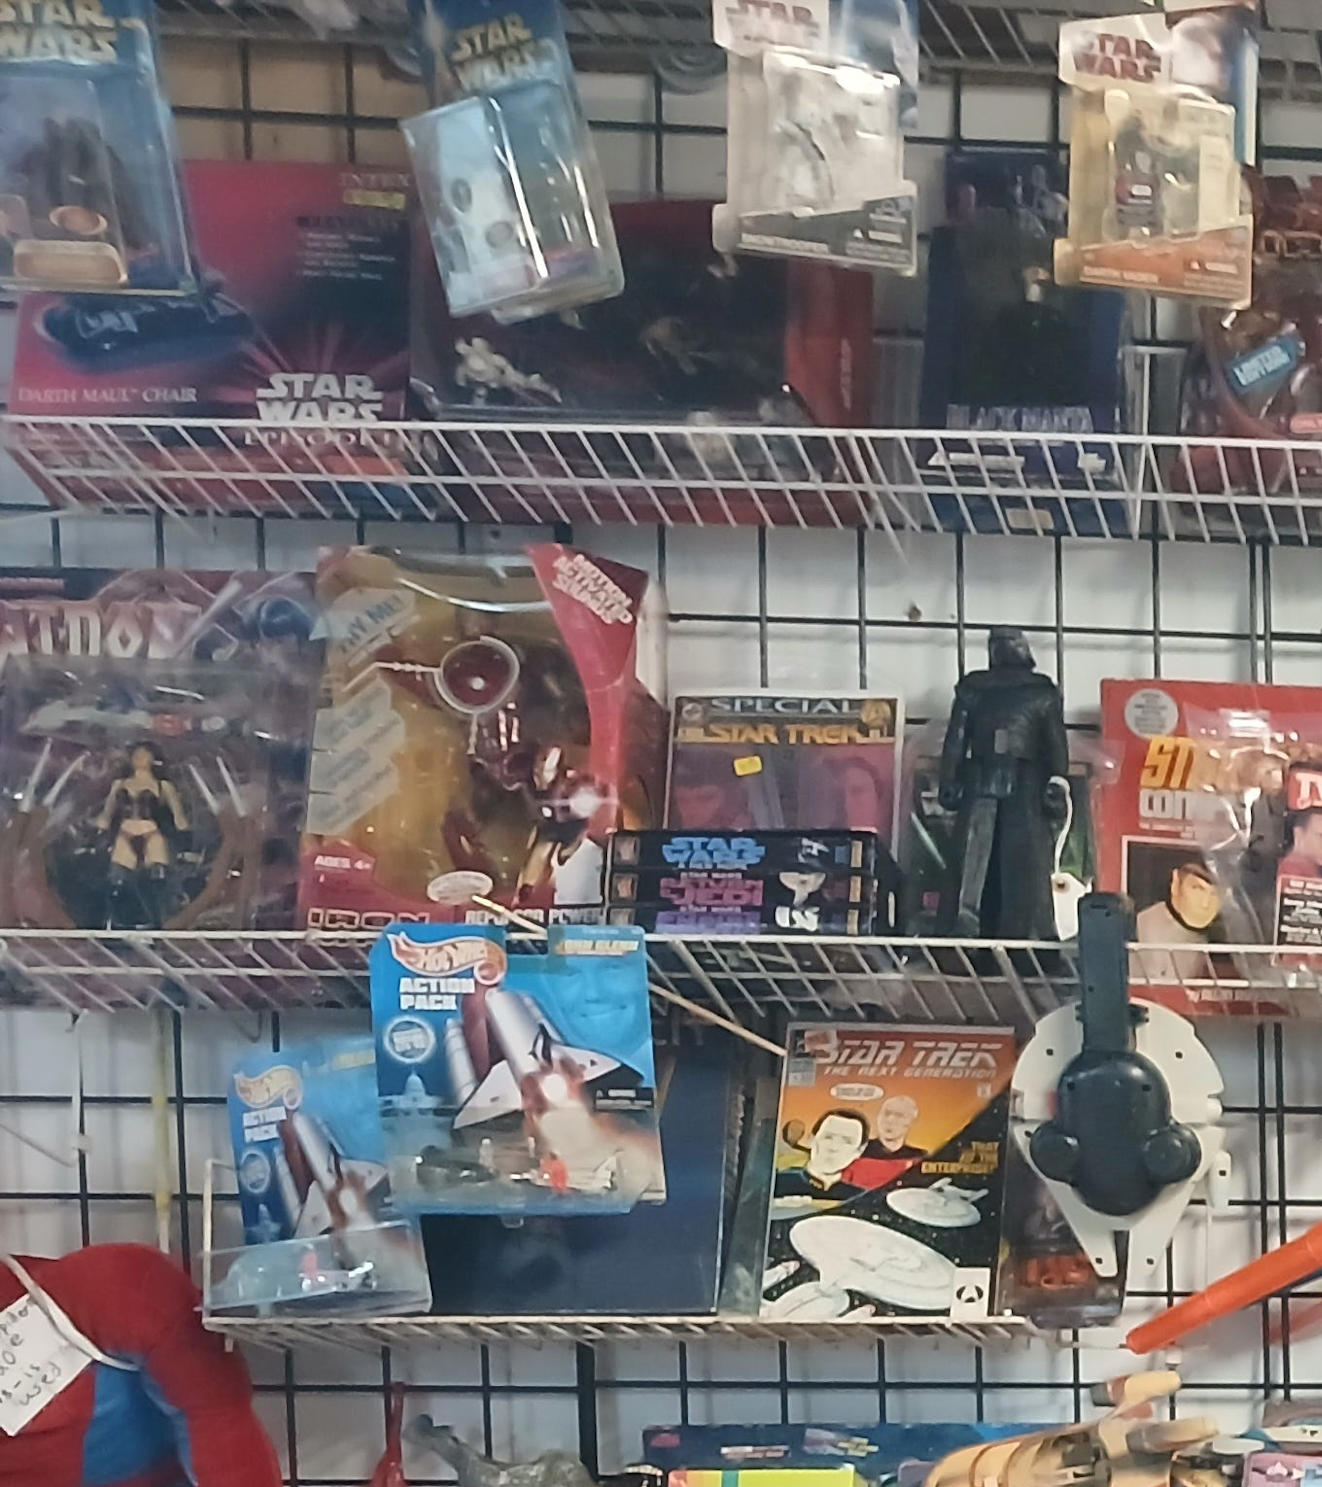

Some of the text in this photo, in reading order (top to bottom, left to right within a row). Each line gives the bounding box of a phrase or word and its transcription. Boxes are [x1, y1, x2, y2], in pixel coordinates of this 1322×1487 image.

[1076, 32, 1161, 60] TAR
[18, 387, 77, 402] DARTH
[142, 387, 199, 403] CHAIR
[256, 372, 383, 400] STAR
[257, 399, 383, 424] WARS
[712, 696, 859, 714] SPECIAL
[703, 722, 862, 746] STAR TREK
[400, 977, 476, 995] ACTION
[400, 994, 458, 1011] PACK
[815, 1039, 1004, 1068] STAR TREK
[824, 1066, 999, 1079] THE NEXT GENERATION
